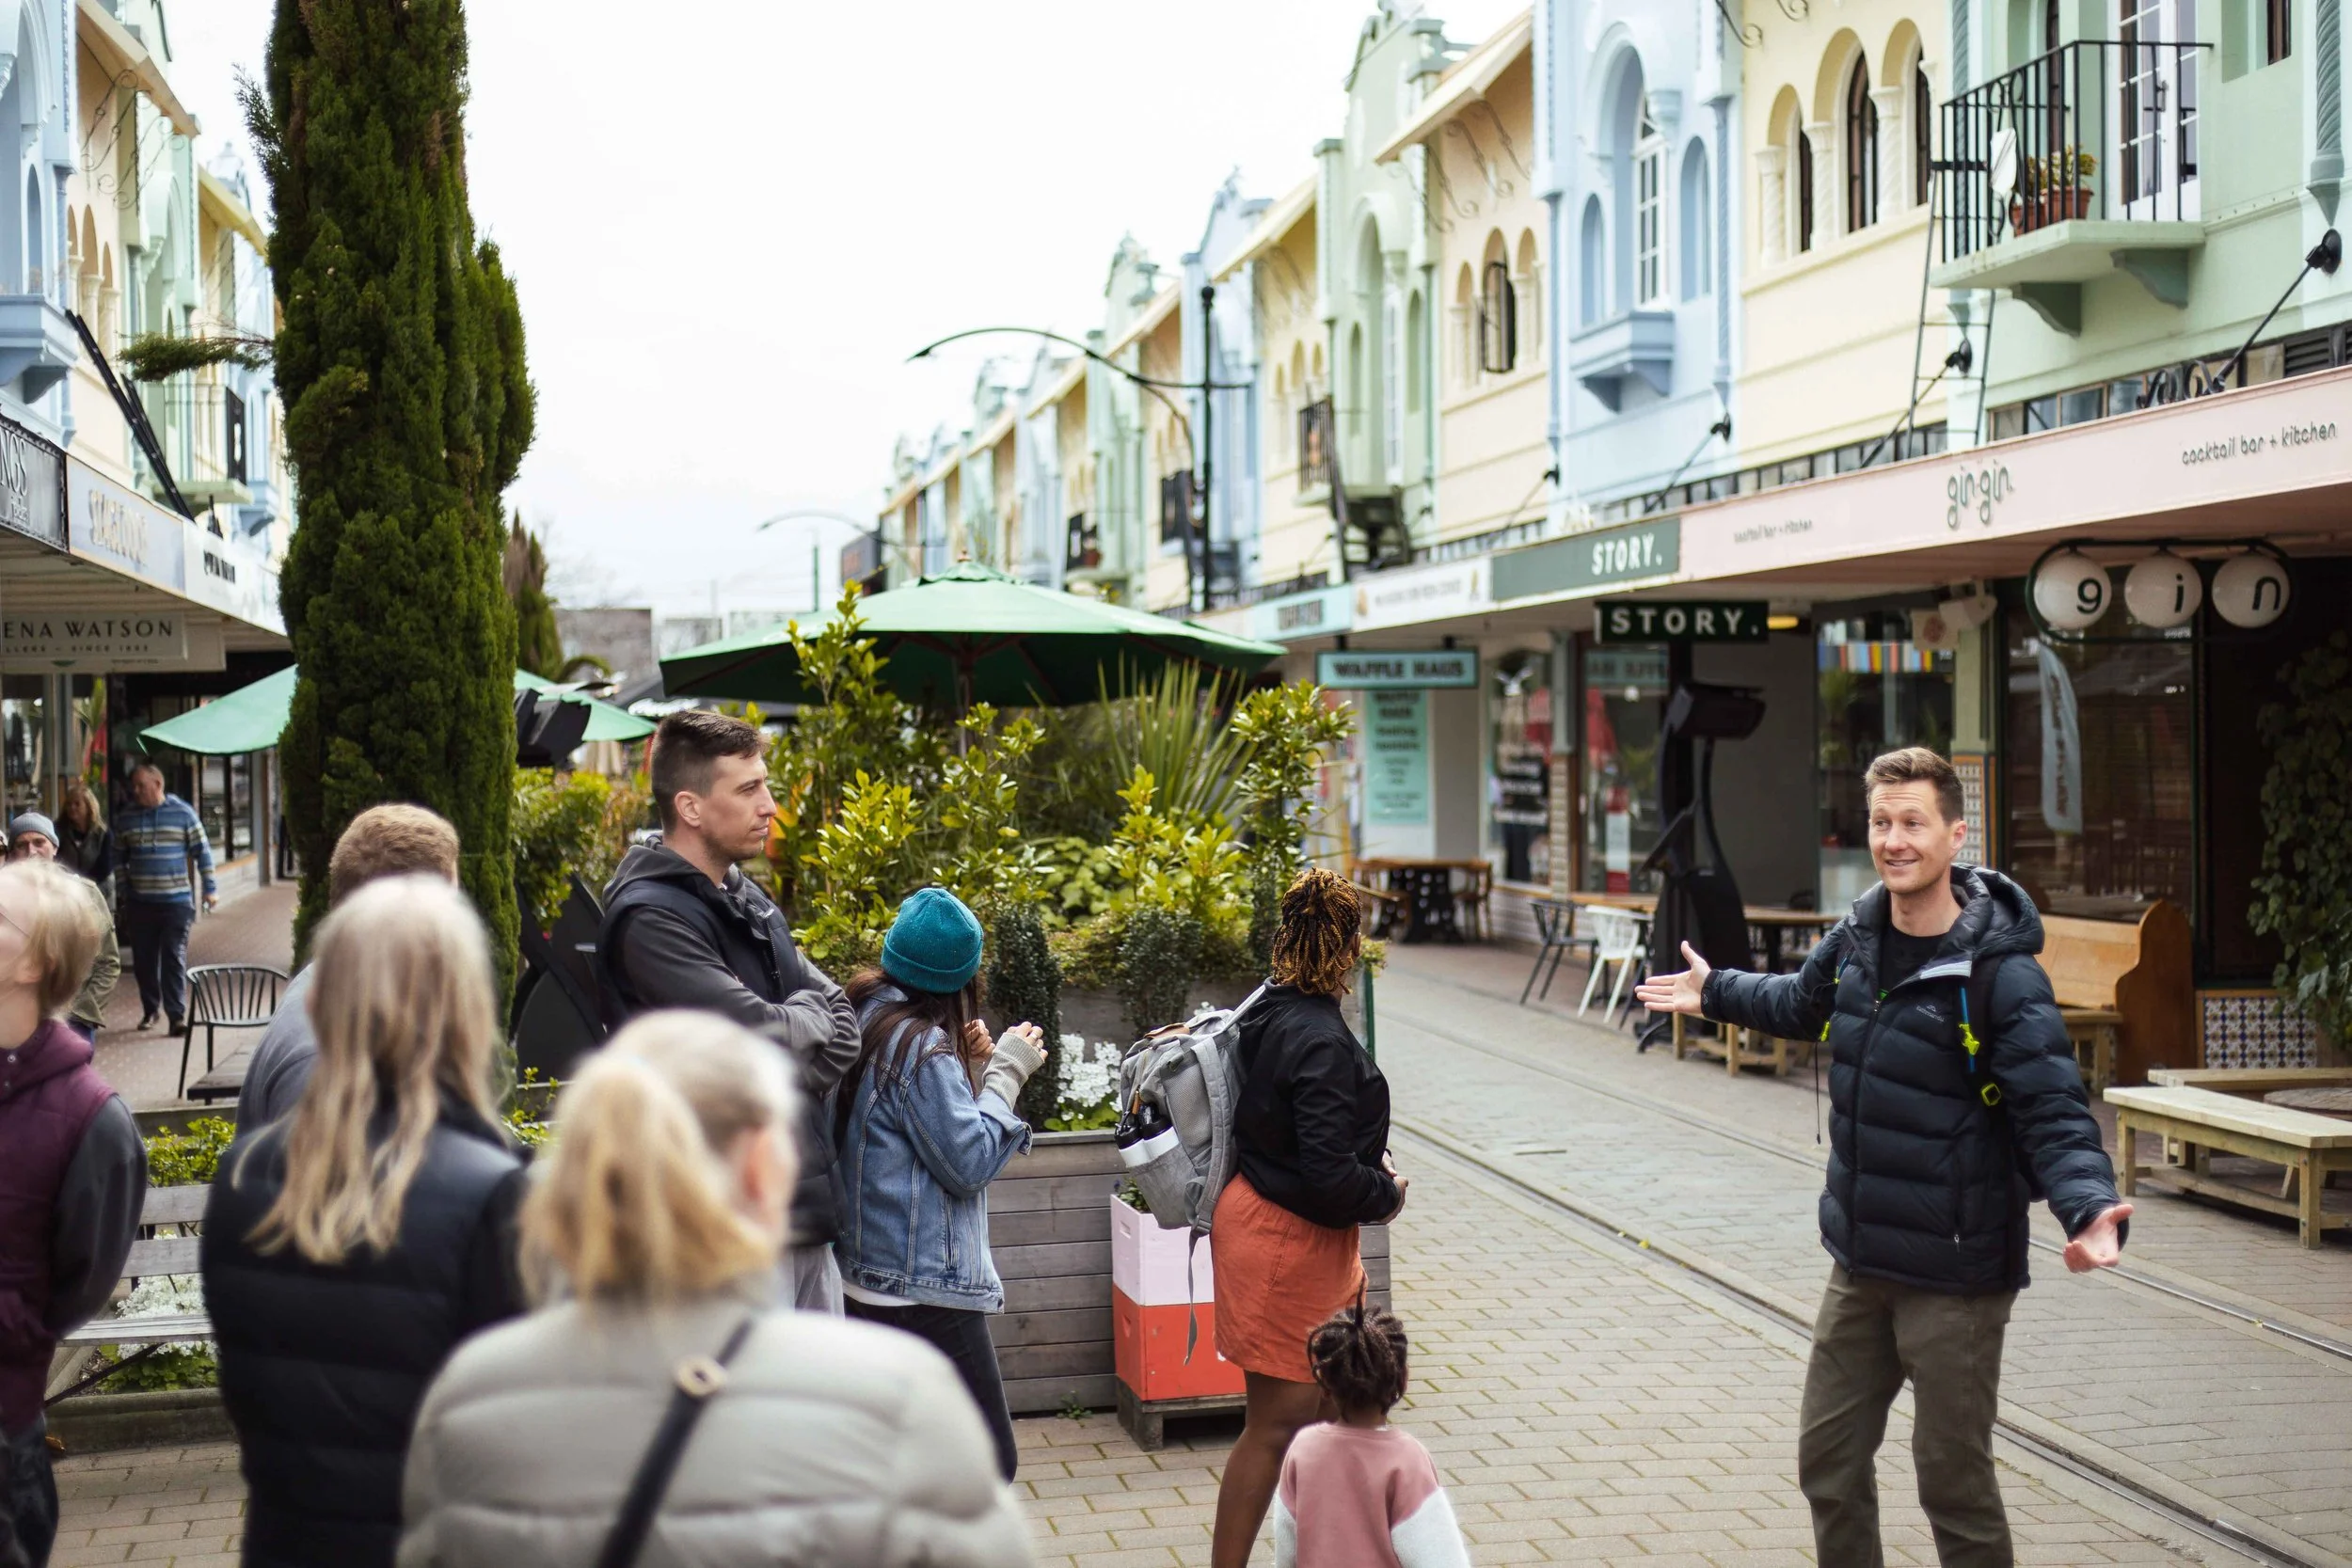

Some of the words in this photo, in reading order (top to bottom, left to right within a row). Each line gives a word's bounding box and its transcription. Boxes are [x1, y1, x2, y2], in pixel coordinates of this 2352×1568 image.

[2182, 437, 2235, 466] cocktail
[2241, 435, 2265, 454] bar
[2281, 421, 2336, 447] kitchen
[1592, 532, 1662, 576] STORY.
[4, 620, 54, 639] ENA
[65, 619, 173, 639] WATSON
[1611, 607, 1760, 636] STORY.
